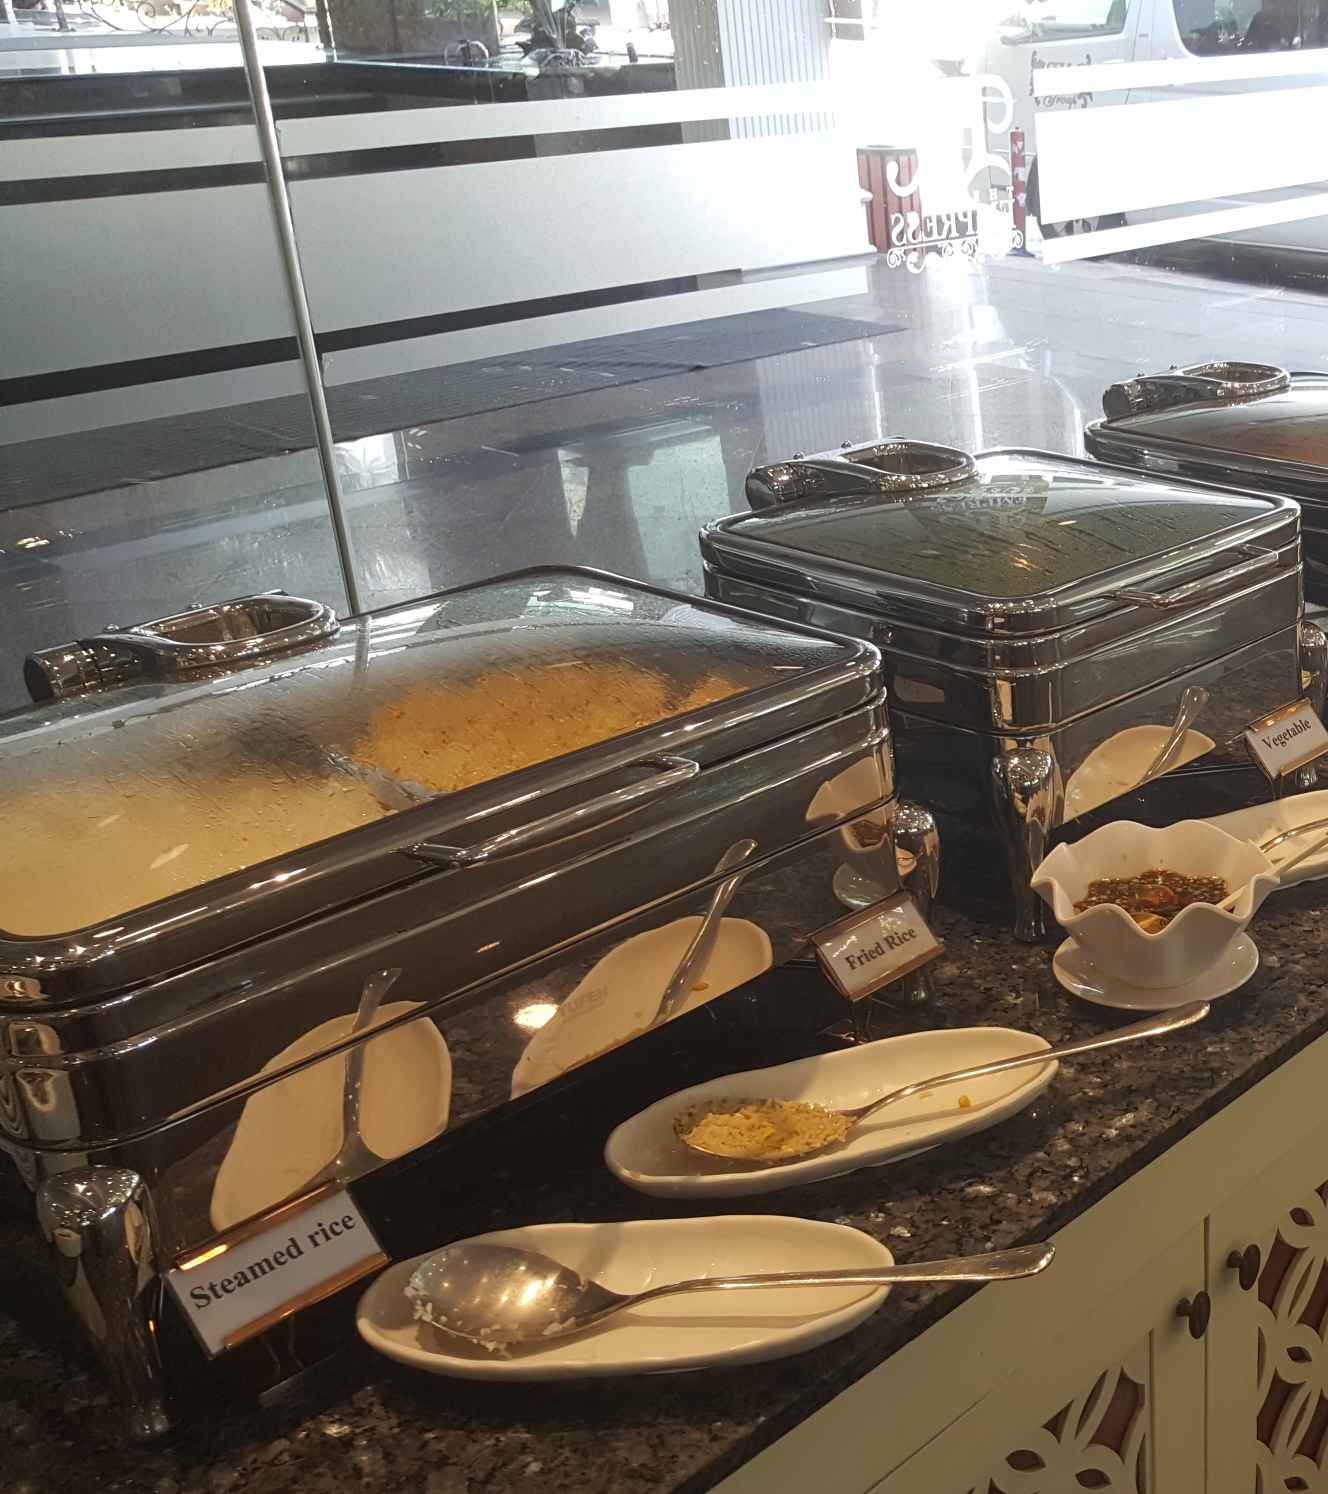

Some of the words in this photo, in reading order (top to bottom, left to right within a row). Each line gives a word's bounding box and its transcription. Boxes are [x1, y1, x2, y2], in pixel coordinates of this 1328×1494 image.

[1261, 719, 1312, 750] Vegetable
[845, 942, 886, 970] Fried
[884, 928, 917, 950] Rice
[190, 1237, 304, 1309] Steamed
[307, 1214, 356, 1248] rice
